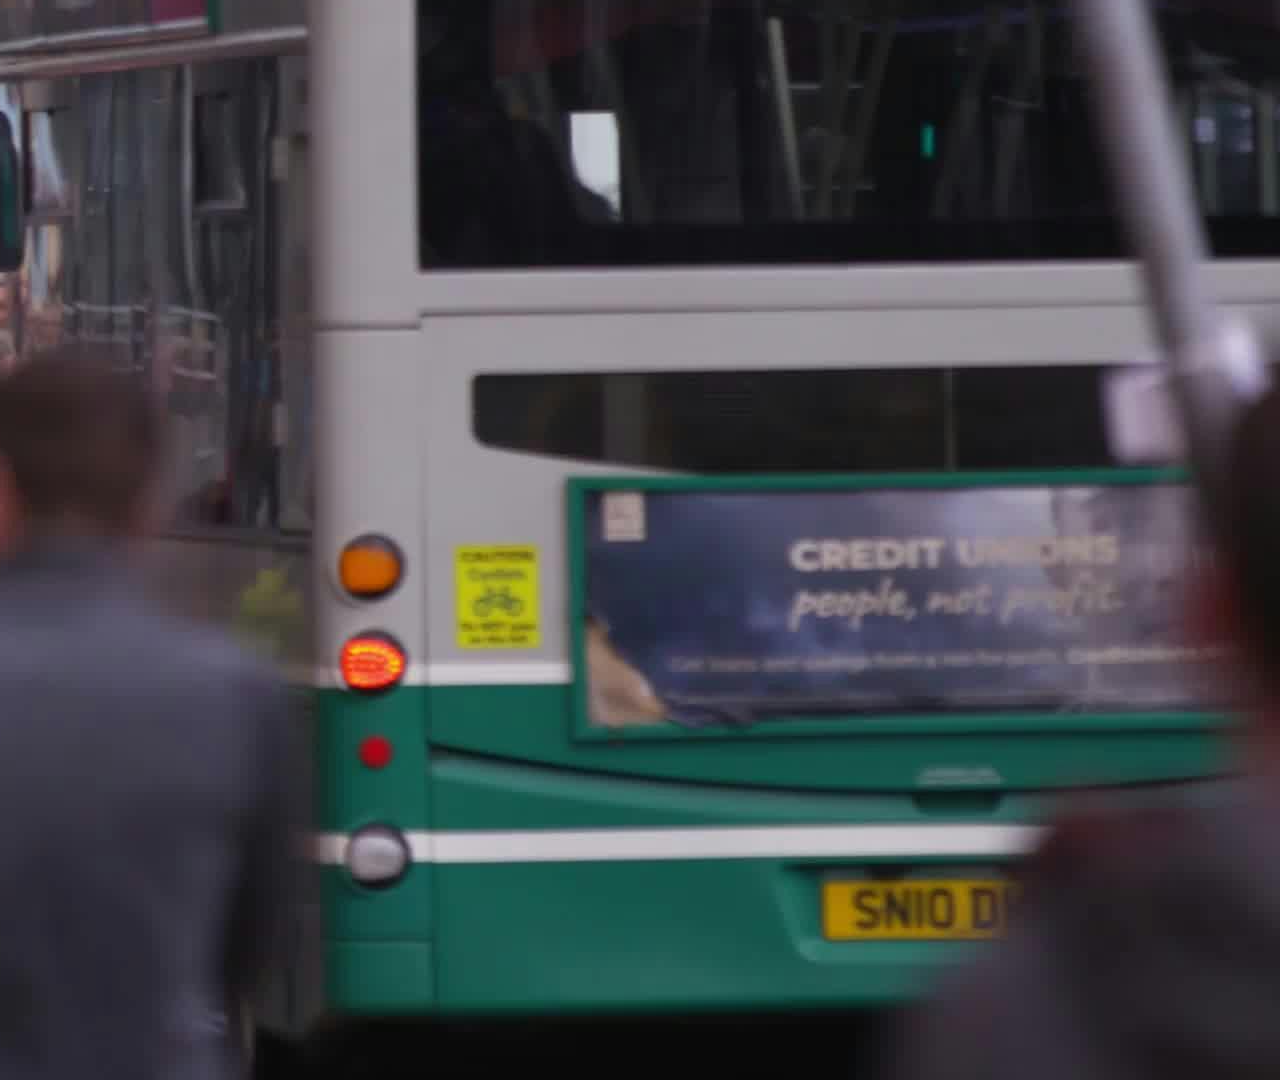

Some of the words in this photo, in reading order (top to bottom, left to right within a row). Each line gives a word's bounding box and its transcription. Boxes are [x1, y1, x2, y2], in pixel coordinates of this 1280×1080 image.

[790, 538, 945, 572] CREDIT
[956, 534, 1121, 570] UNIONS
[787, 576, 918, 633] people,
[927, 582, 993, 617] not
